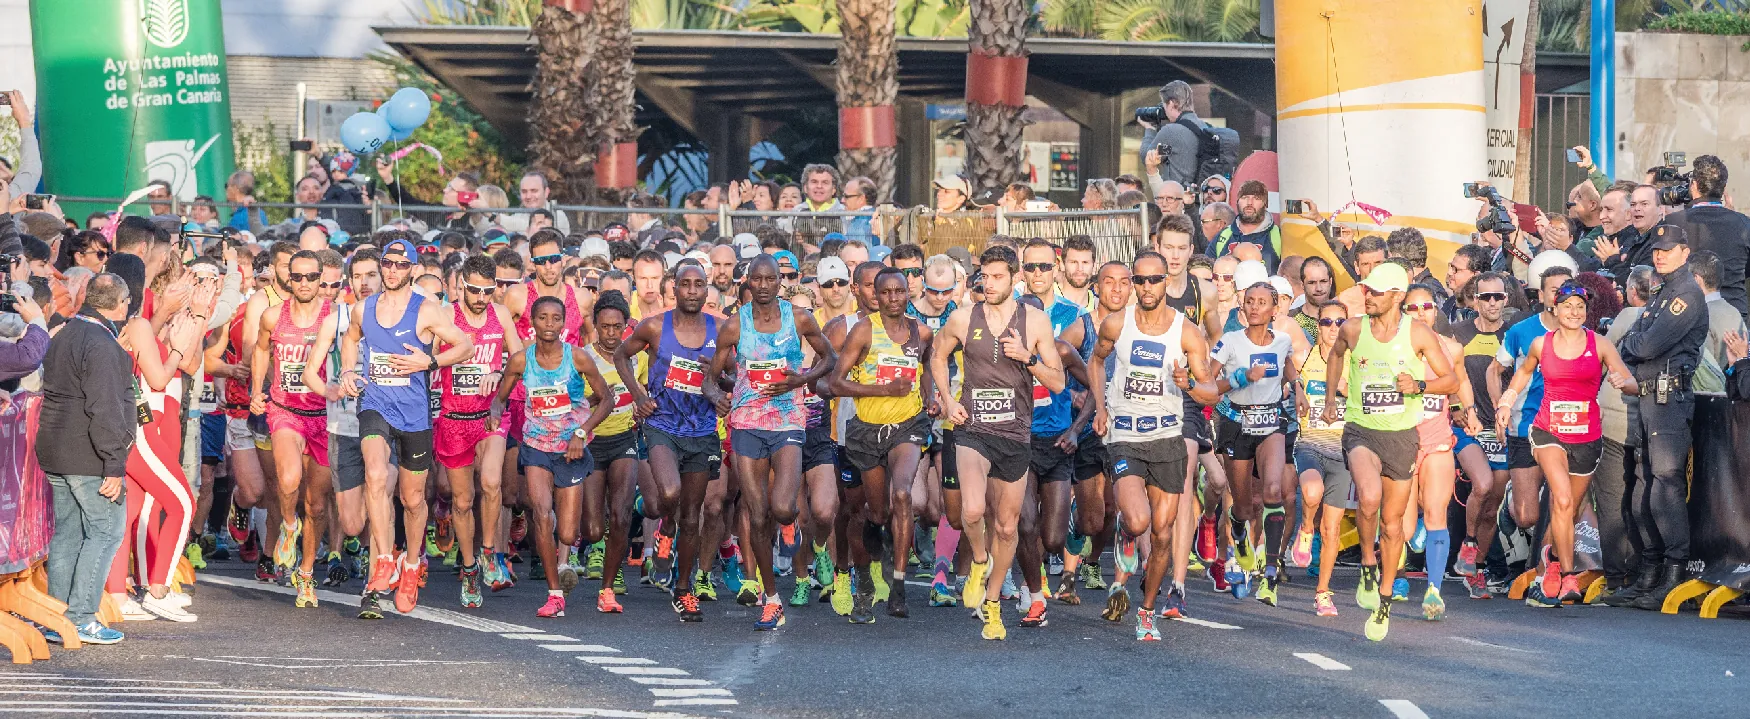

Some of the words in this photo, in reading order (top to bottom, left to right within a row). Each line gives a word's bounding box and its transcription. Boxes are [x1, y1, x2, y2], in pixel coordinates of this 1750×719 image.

[103, 52, 219, 76] Ayuntamiento
[104, 75, 127, 91] de
[139, 73, 167, 89] Las
[175, 69, 221, 86] Palmas
[106, 93, 128, 110] de
[131, 91, 173, 108] Gran
[176, 87, 222, 105] Canaria
[1487, 158, 1515, 179] CIUDAD
[686, 371, 693, 382] 1
[763, 370, 772, 381] 6
[894, 367, 903, 378] 2
[457, 374, 482, 386] 482
[1129, 379, 1161, 394] 4795
[543, 396, 558, 407] 10
[1366, 392, 1400, 404] 4737
[976, 399, 1012, 412] 3004
[1247, 413, 1276, 425] 3008
[1562, 412, 1578, 424] 68
